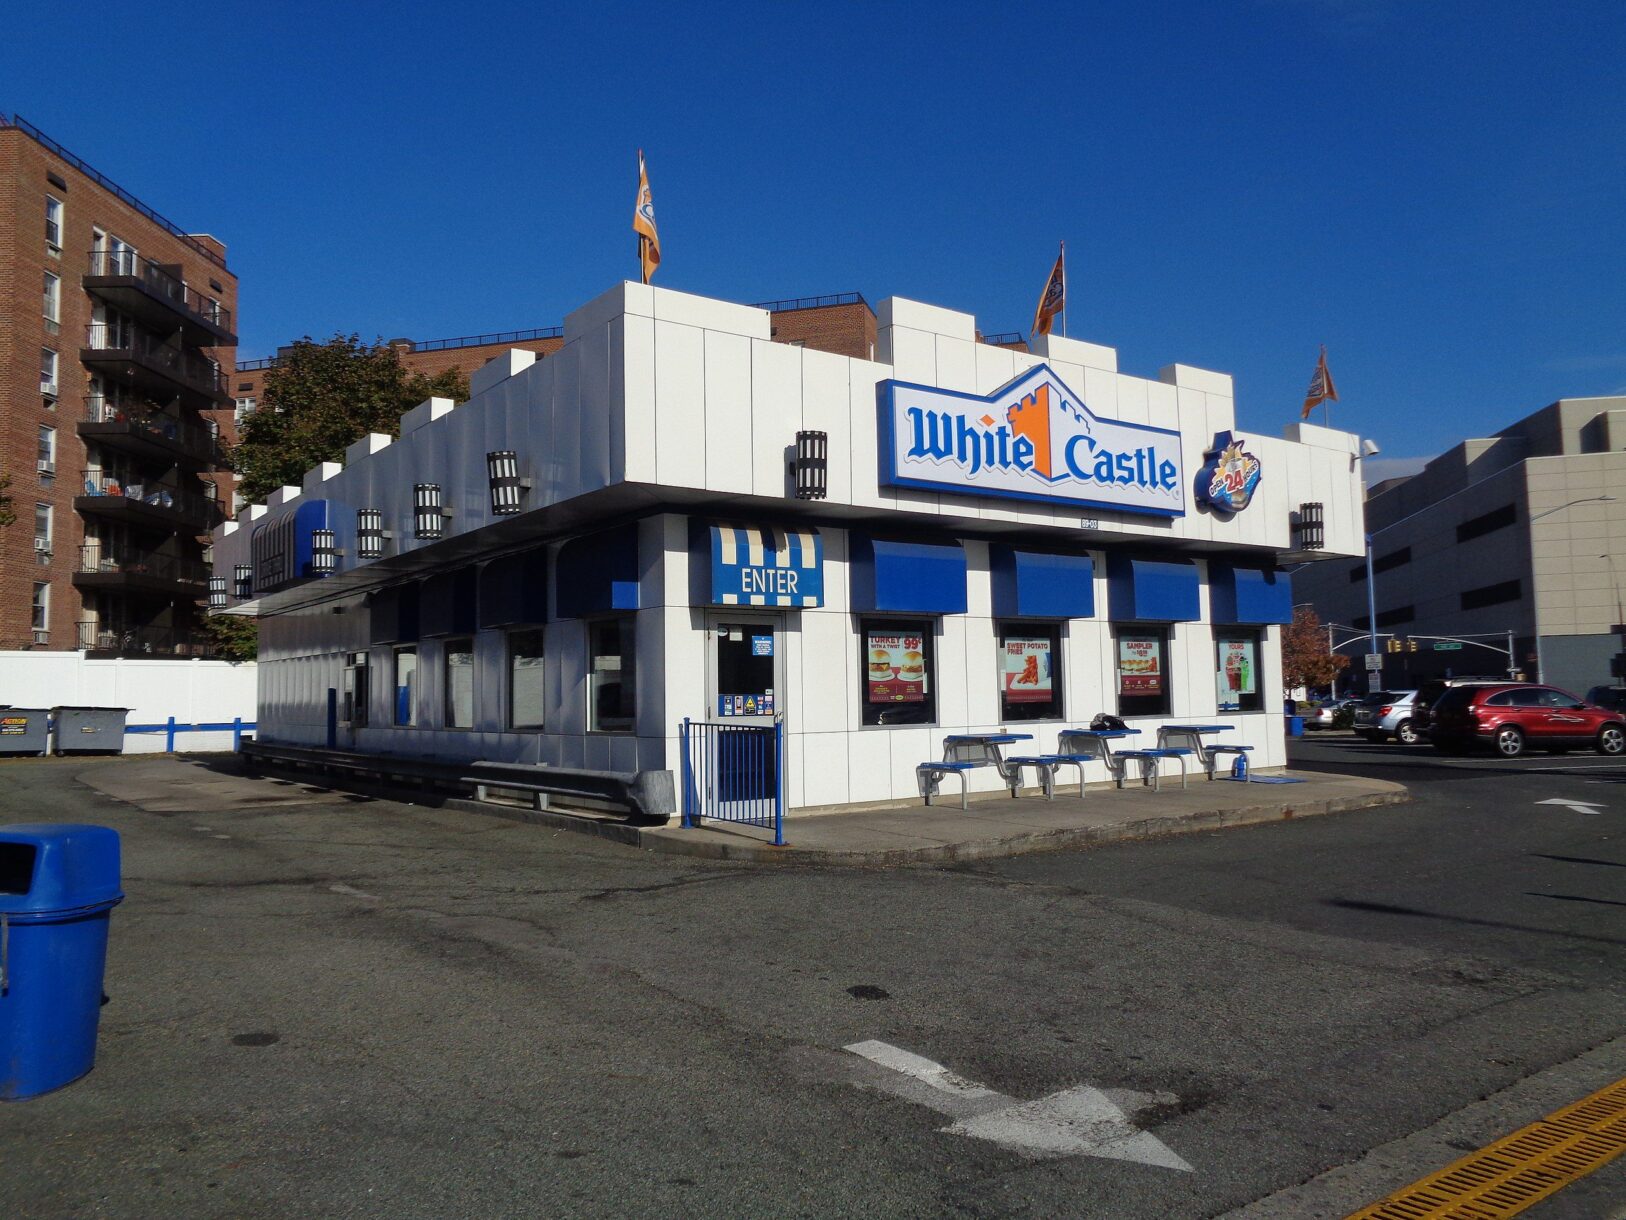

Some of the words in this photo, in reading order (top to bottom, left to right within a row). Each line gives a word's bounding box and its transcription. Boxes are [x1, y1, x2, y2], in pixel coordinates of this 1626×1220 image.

[907, 407, 1034, 475] White
[1065, 435, 1177, 491] Castle
[1210, 477, 1224, 495] OPEN
[1225, 470, 1244, 492] 24
[1243, 461, 1258, 482] HOURS
[742, 568, 798, 594] ENTER
[869, 636, 901, 644] TURKEY
